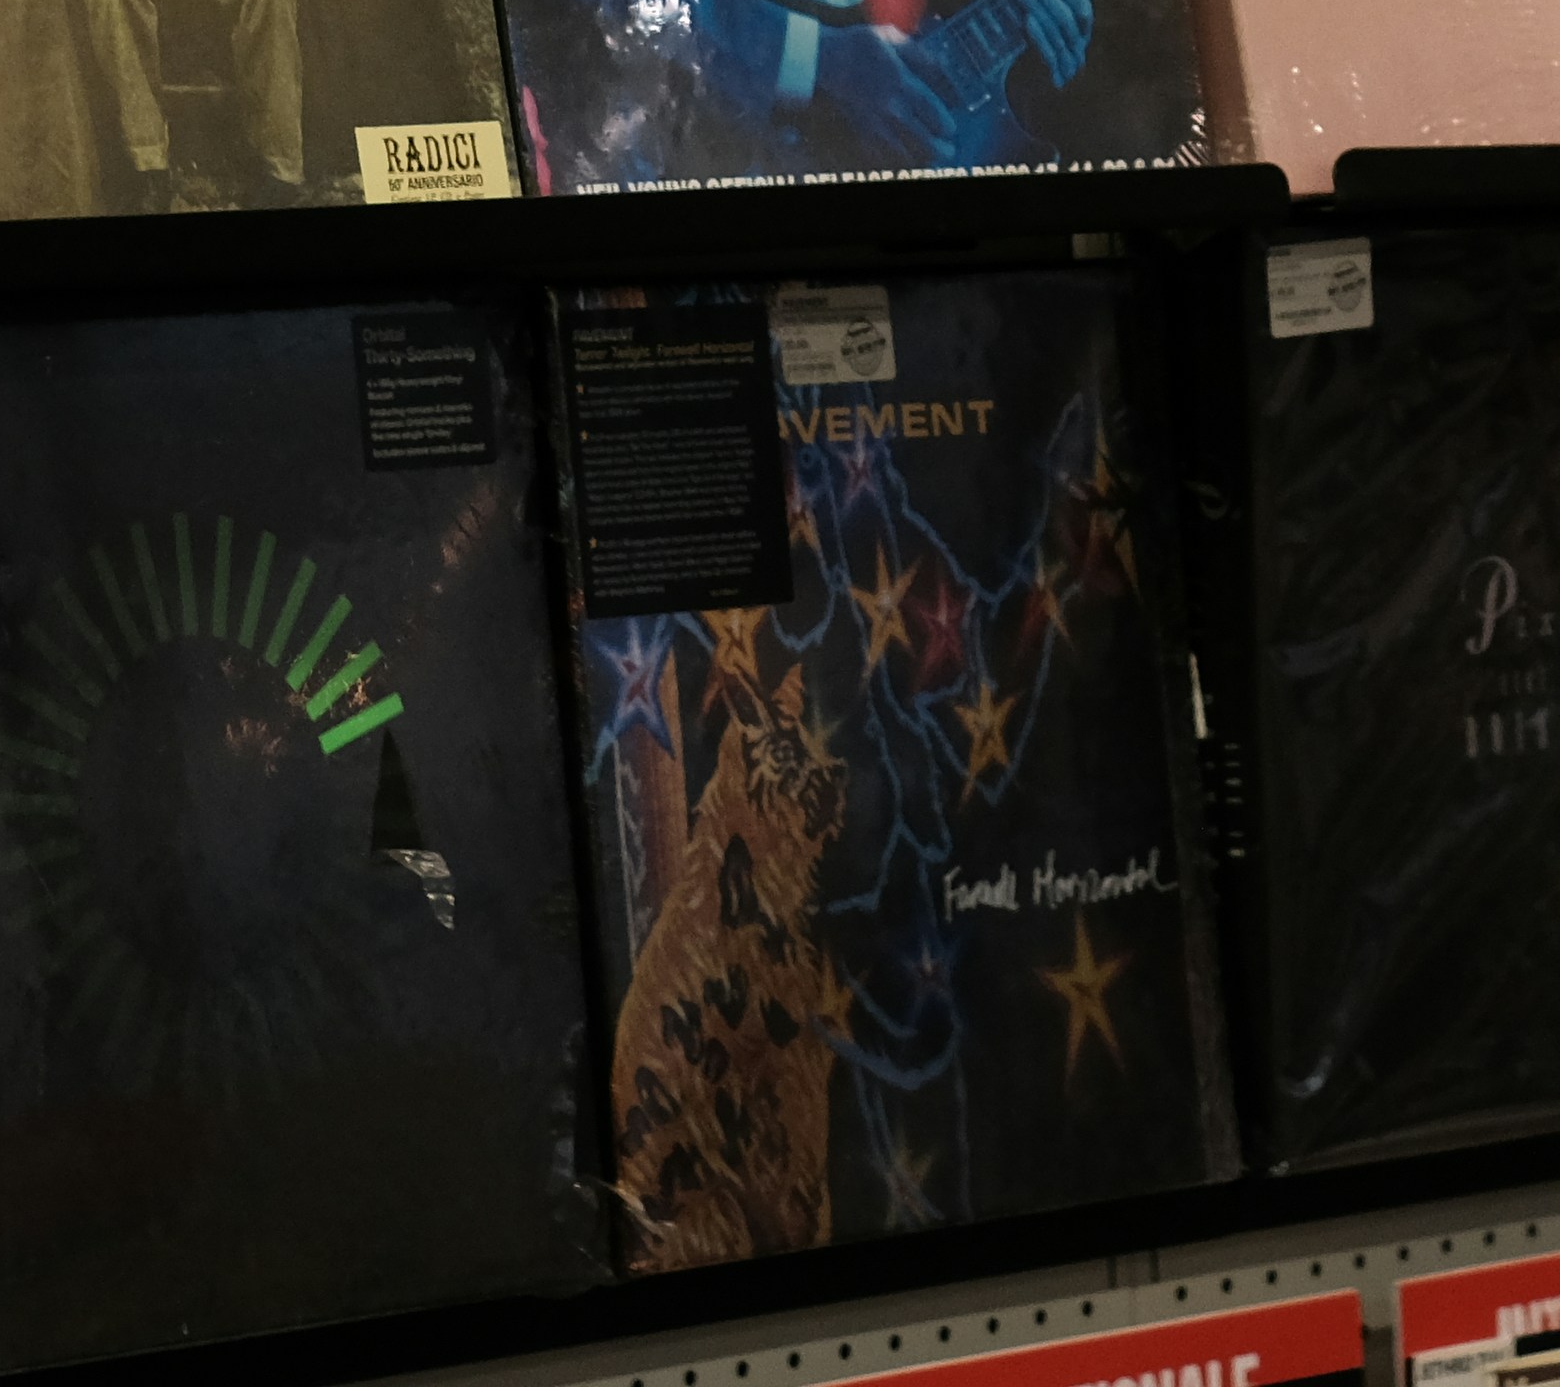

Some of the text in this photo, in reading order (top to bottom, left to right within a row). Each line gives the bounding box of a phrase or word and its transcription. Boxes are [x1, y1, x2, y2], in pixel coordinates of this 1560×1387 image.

[383, 132, 482, 173] RADICI
[408, 173, 484, 190] ANNIVERSARIO
[780, 400, 996, 444] VEMENT
